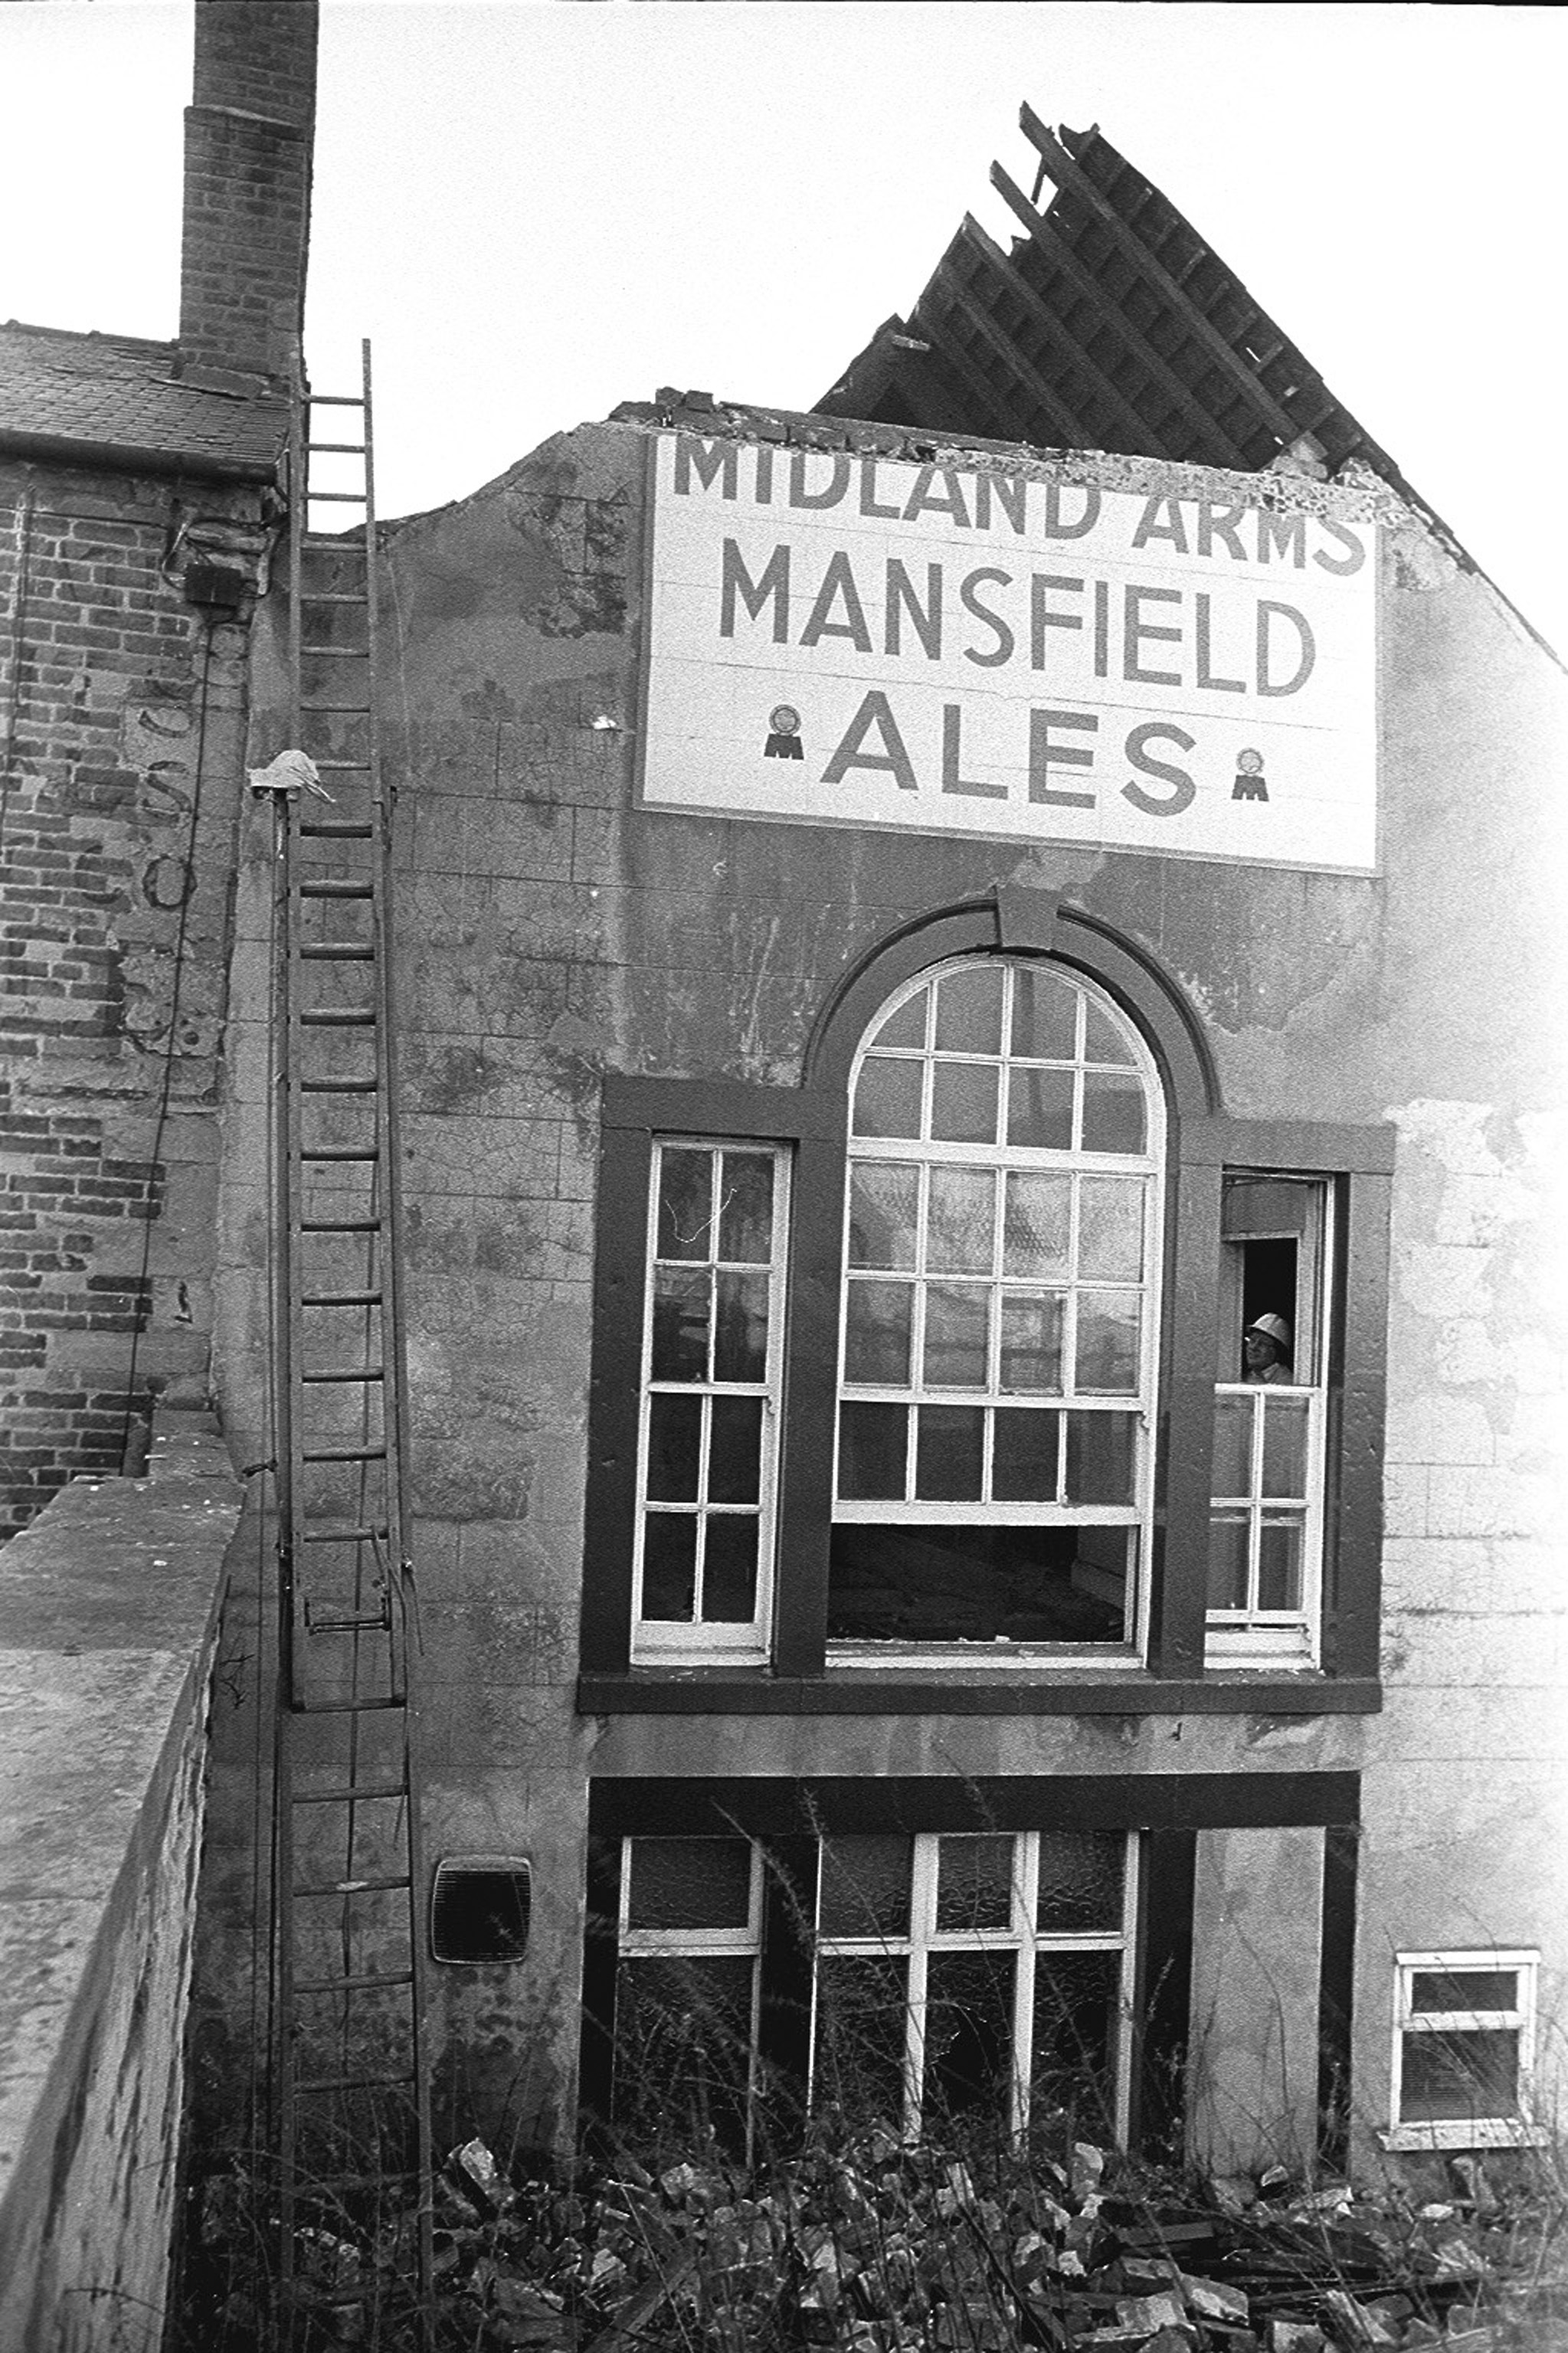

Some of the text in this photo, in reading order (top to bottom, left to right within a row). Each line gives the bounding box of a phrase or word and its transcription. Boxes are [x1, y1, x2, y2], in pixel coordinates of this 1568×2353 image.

[673, 432, 1366, 576] MIDLAND ARMS
[719, 536, 1317, 696] MANSFIELD
[820, 689, 1198, 817] ALES
